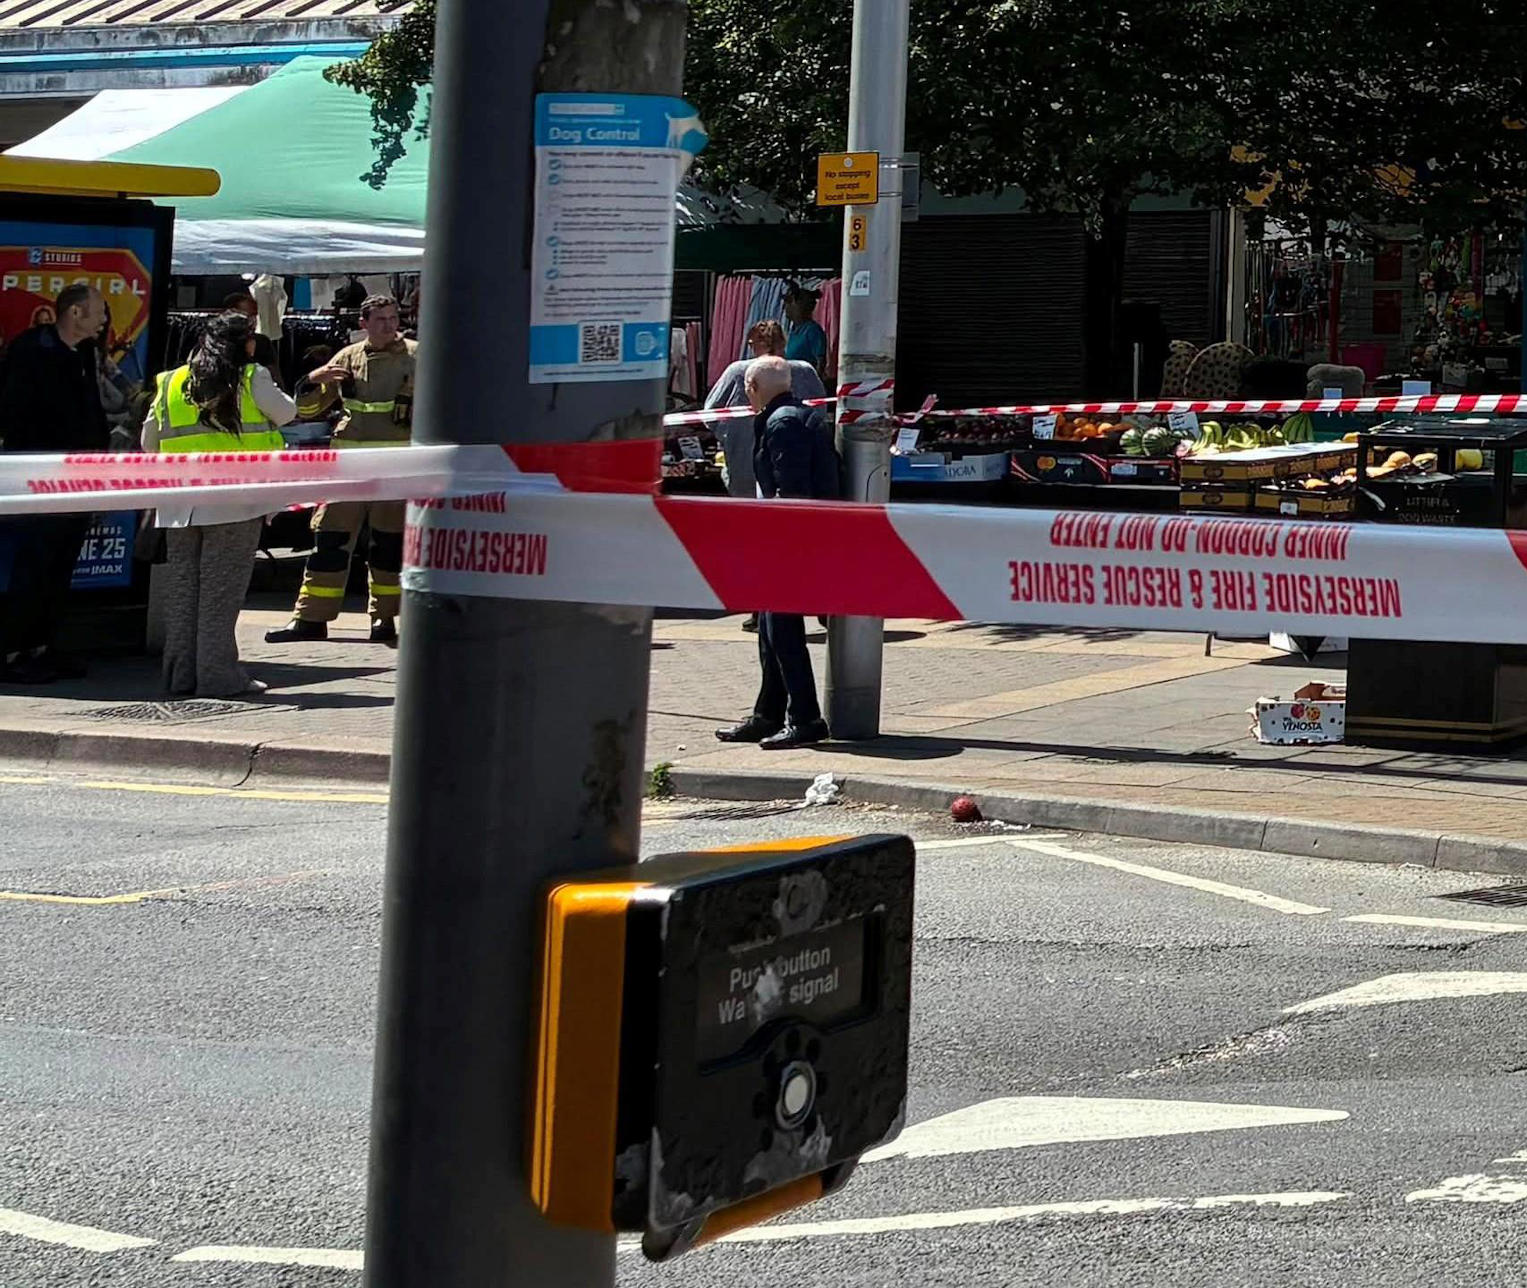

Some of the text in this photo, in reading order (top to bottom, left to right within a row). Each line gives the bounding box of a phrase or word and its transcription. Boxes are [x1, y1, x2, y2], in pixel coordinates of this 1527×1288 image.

[549, 127, 640, 143] Dog Control
[835, 182, 860, 191] except
[838, 170, 871, 180] stopping
[824, 192, 870, 201] local buses
[44, 253, 82, 262] STUDIOS
[101, 538, 126, 559] 25
[1050, 511, 1116, 549] ENTER
[1114, 511, 1157, 552] NOT
[1285, 525, 1353, 560] INNER
[428, 528, 548, 575] MERSEYSIDE
[1008, 561, 1096, 605] SERVICE
[1101, 565, 1183, 608] RESCUE
[1210, 570, 1257, 612] FIRE
[1263, 571, 1402, 618] MERSEYSIDE
[789, 967, 839, 1004] signal
